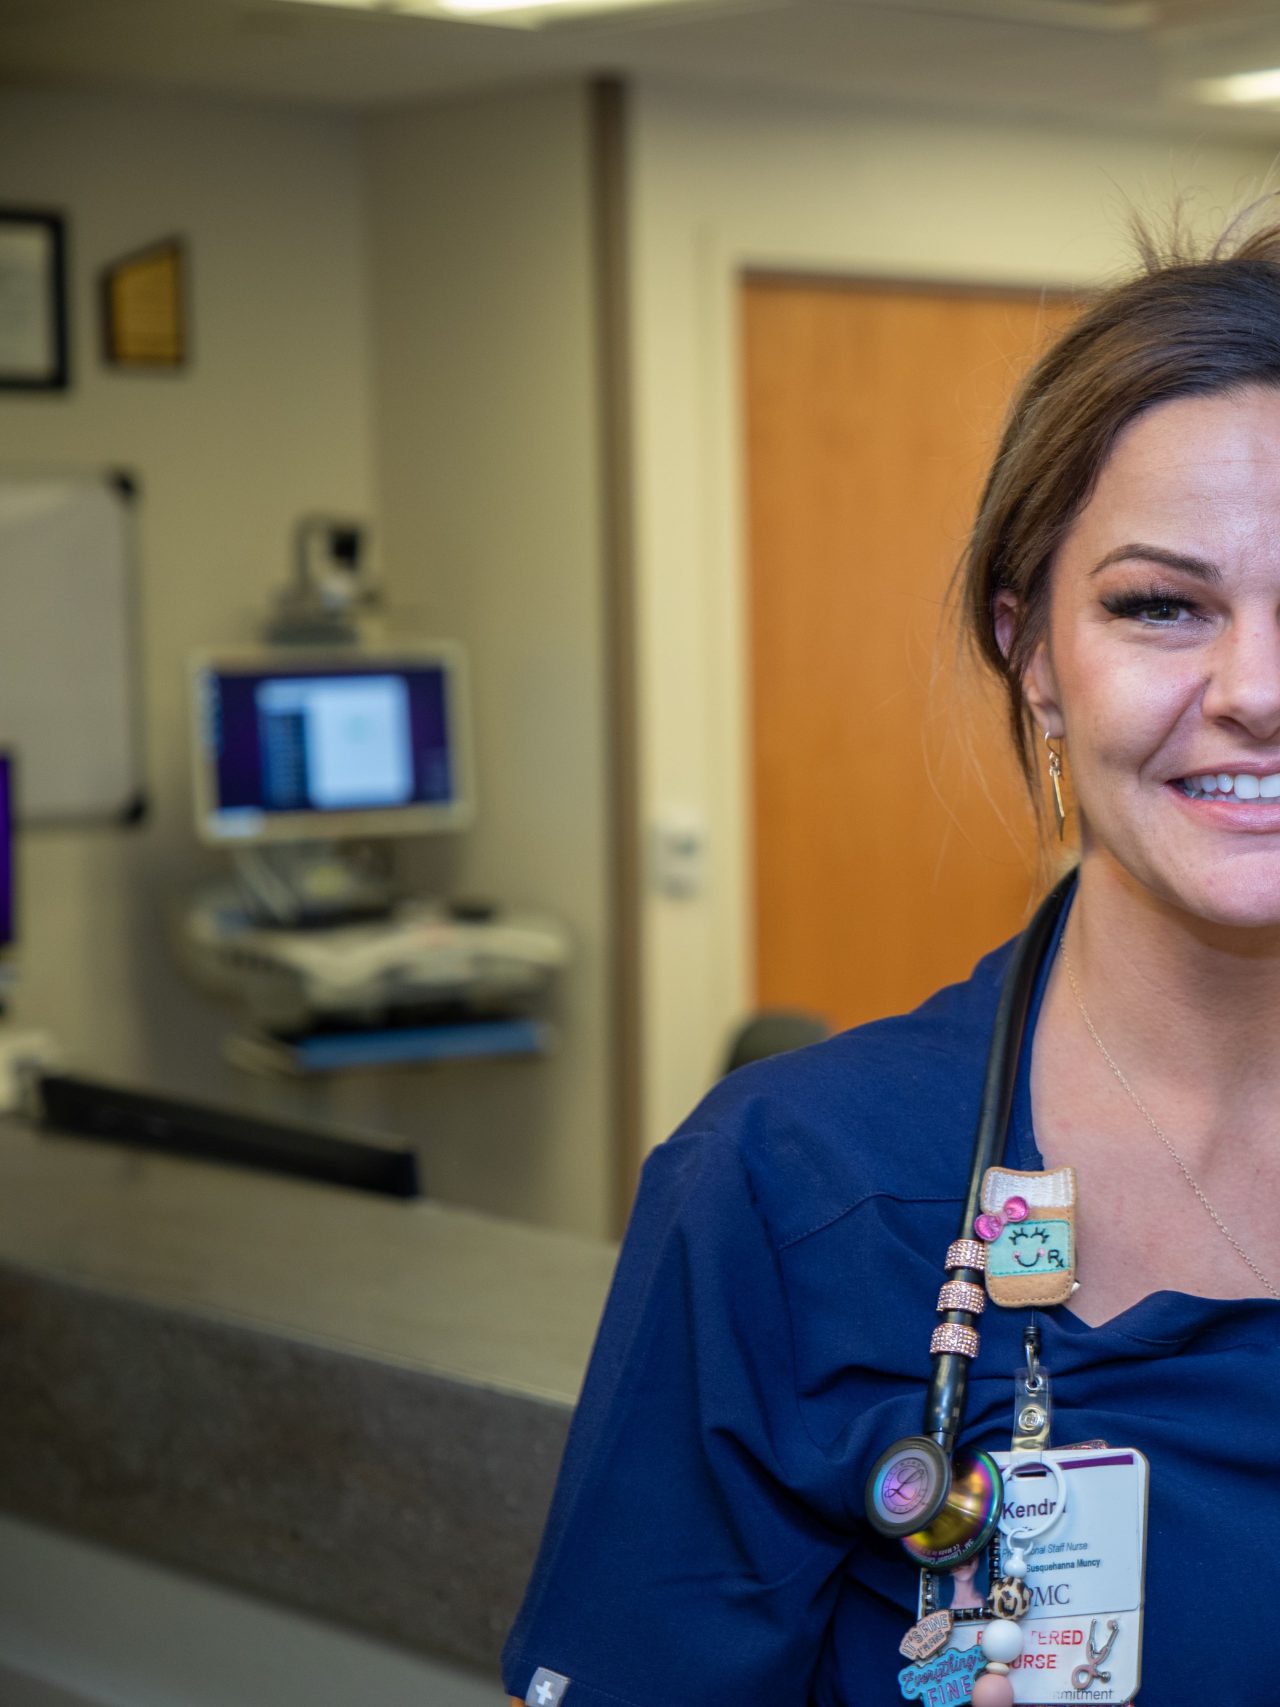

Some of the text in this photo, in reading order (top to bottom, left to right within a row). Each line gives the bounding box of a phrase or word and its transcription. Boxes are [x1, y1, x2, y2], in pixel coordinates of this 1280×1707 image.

[1002, 1498, 1066, 1519] Kendr
[1047, 1542, 1066, 1553] Staff
[1066, 1541, 1088, 1551] Nurse
[1026, 1558, 1101, 1574] Susquehanna Muncy
[1011, 1654, 1057, 1669] URSE
[928, 1675, 973, 1707] FINE
